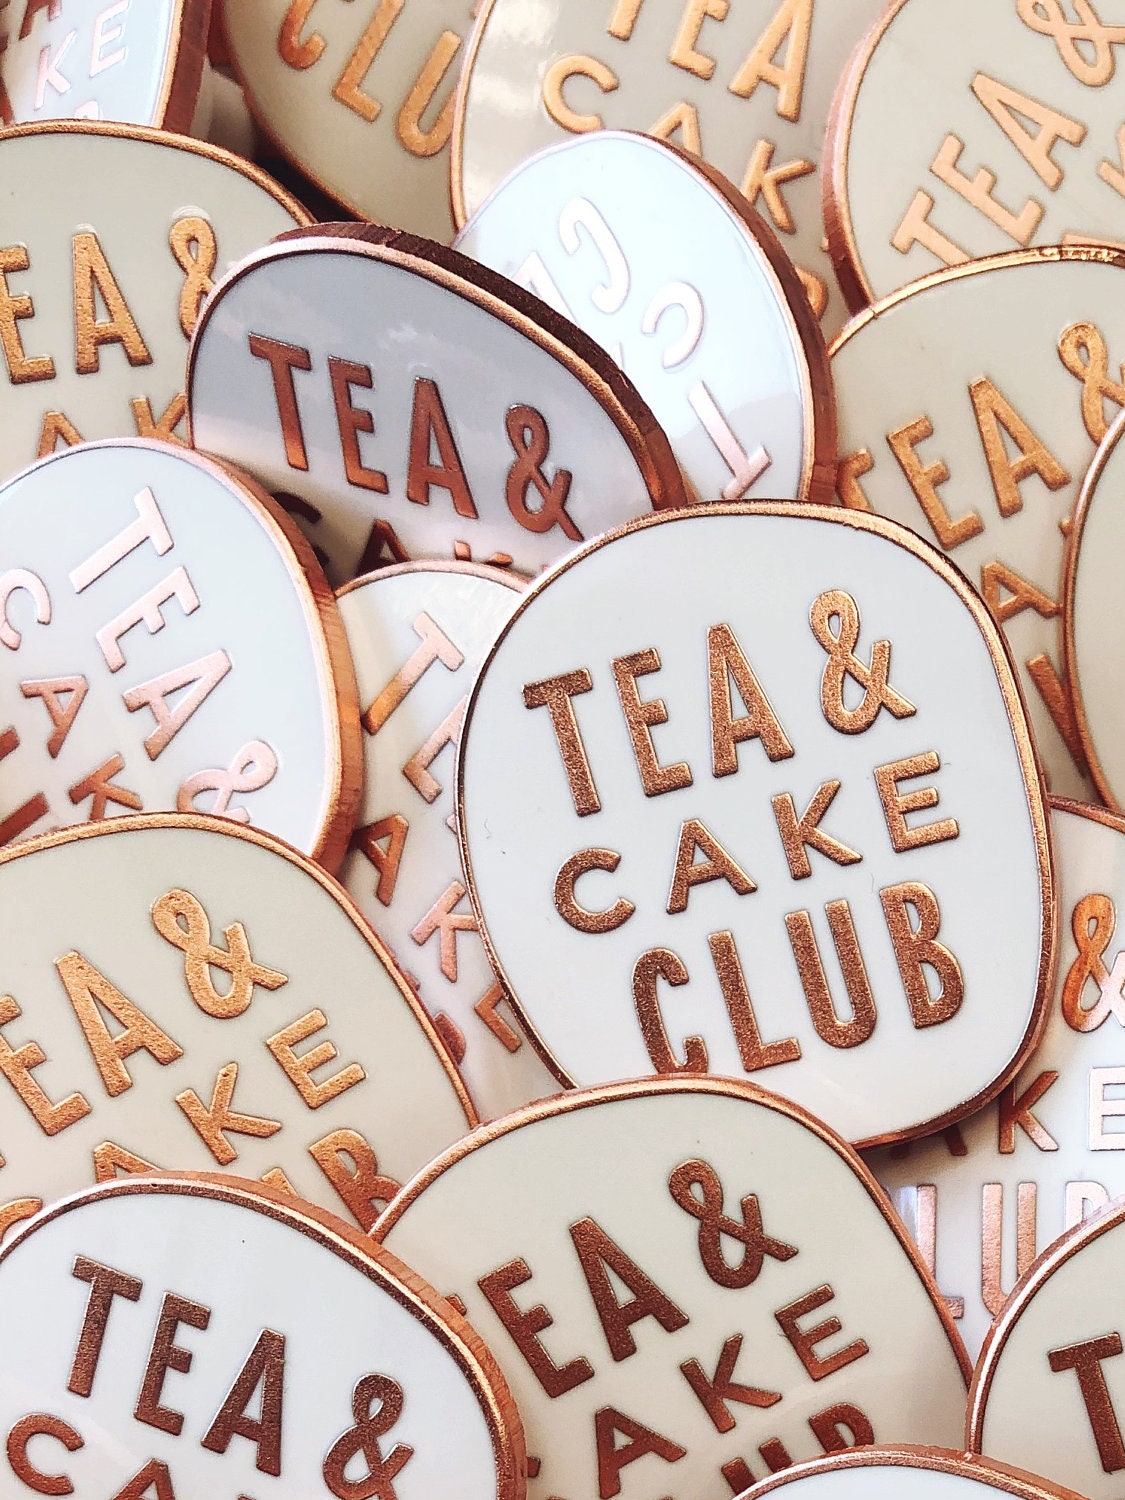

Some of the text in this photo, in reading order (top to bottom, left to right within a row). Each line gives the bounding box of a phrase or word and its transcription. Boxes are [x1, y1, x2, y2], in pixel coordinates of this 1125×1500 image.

[892, 72, 1088, 267] TEA
[0, 225, 153, 385] EA
[247, 331, 479, 519] TEA
[503, 402, 584, 542] &
[69, 487, 232, 761] TEA
[521, 623, 794, 816] TEA
[809, 589, 916, 735] &
[553, 750, 959, 934] CAKE
[151, 888, 288, 1019] &
[633, 881, 965, 1073] CLUB
[67, 1255, 285, 1477] TEA
[455, 1159, 798, 1398] EA &
